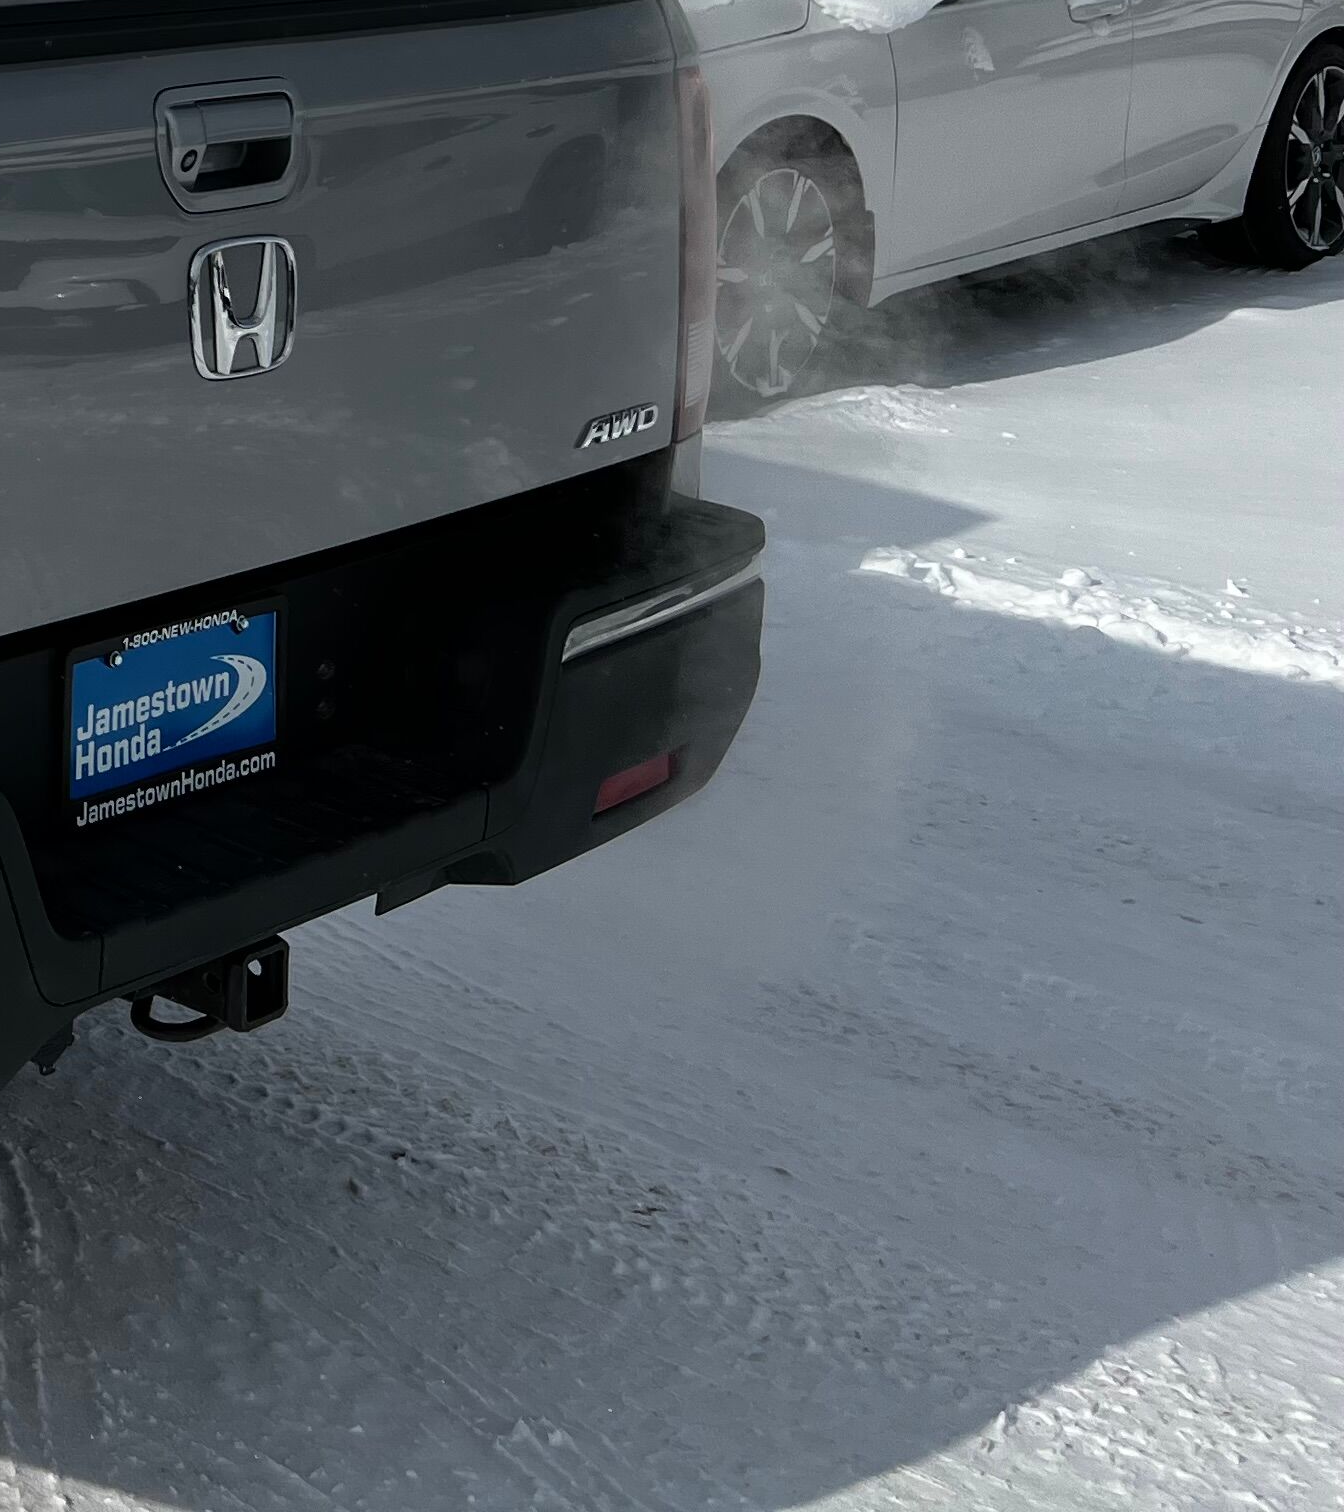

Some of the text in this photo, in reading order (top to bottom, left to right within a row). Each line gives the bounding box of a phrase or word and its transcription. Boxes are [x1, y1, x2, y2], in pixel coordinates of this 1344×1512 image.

[574, 402, 659, 449] AWD
[122, 609, 238, 650] 1-800-NEW-HONDA
[76, 671, 231, 742] Jamestown
[75, 724, 162, 780] Honda
[76, 751, 276, 827] JamestownHonda.com
